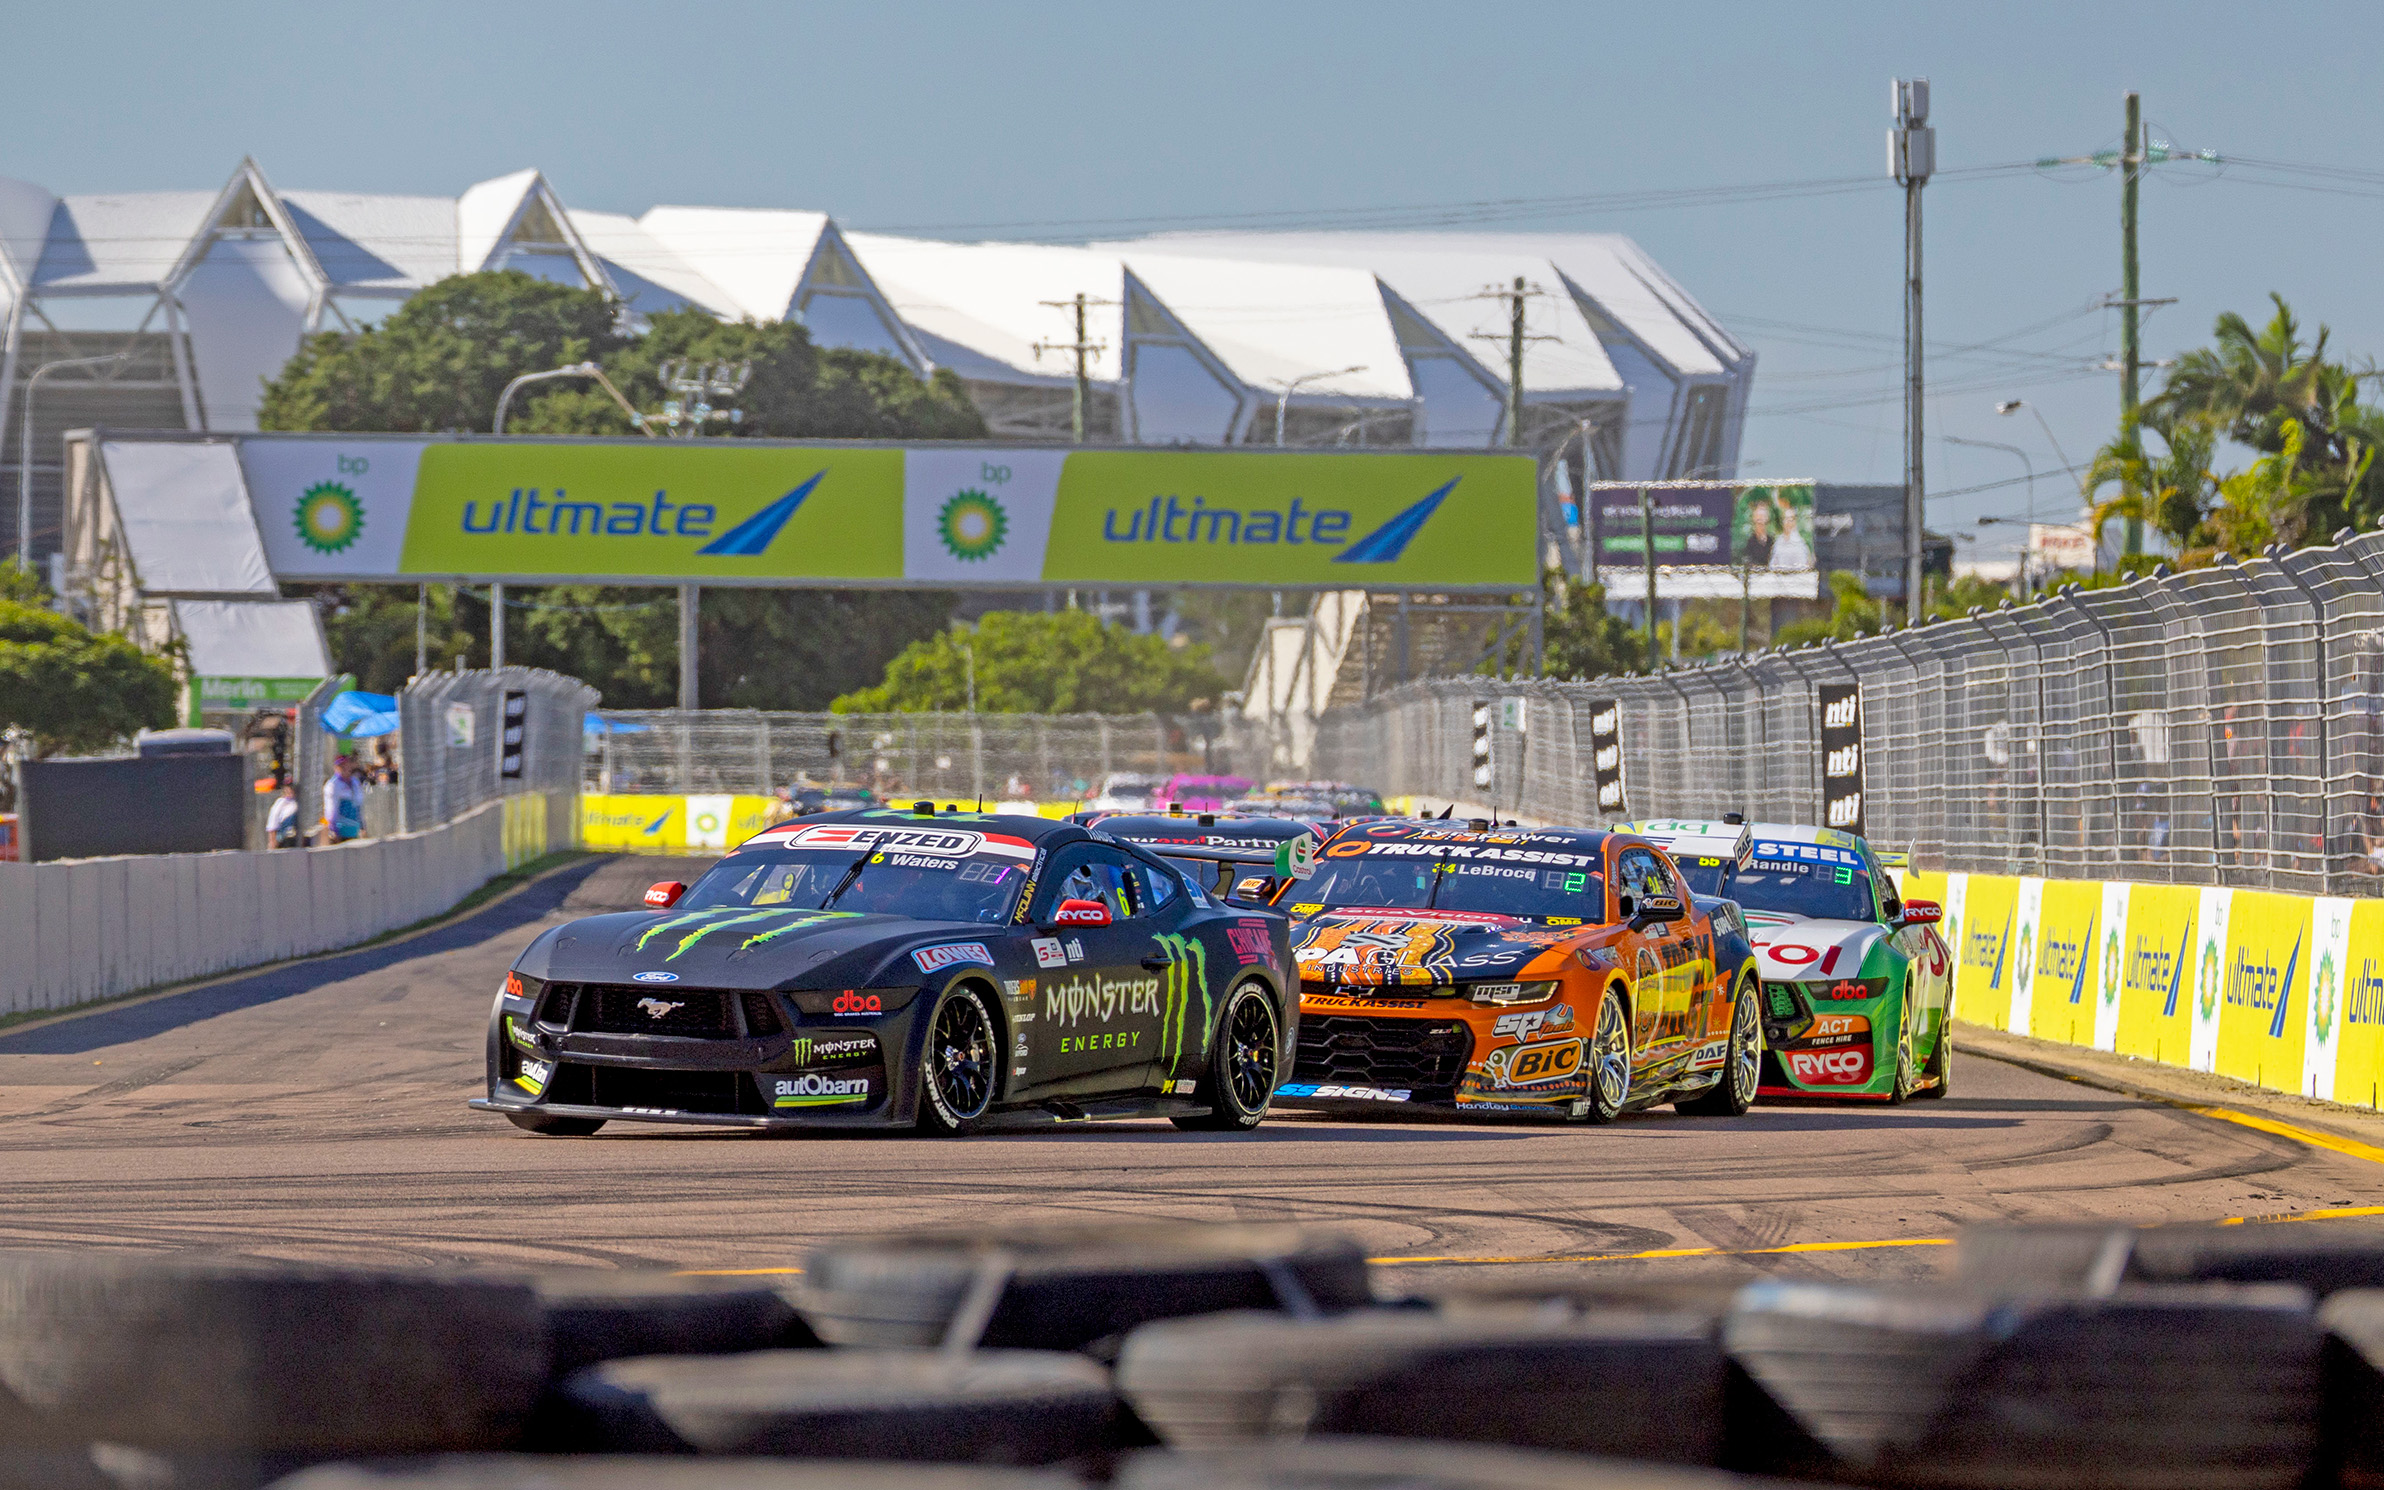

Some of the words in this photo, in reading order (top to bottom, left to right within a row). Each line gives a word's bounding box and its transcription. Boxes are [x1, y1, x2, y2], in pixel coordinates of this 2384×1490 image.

[338, 455, 369, 476] bp
[982, 463, 1012, 485] bp
[461, 489, 718, 537] ultimate
[1104, 496, 1352, 545] ultimate
[201, 678, 266, 697] Merlin
[1825, 694, 1856, 724] nti
[1828, 743, 1858, 773] nti
[1830, 792, 1860, 822] nti
[852, 831, 965, 850] ENZED
[870, 853, 885, 864] 6
[890, 854, 958, 869] Waters
[1758, 843, 1858, 866] STEEL
[1458, 864, 1537, 881] LeBrocq
[1699, 857, 1720, 867] 55
[1748, 860, 1809, 873] Randle
[1564, 873, 1586, 892] 2
[1116, 887, 1131, 916] 6
[1290, 903, 1325, 914] OMP
[1055, 909, 1104, 921] RYCO
[1546, 916, 1583, 926] OMP
[1905, 906, 1942, 918] RYCO
[2331, 911, 2341, 945] bp
[919, 945, 990, 970] LOWES
[2126, 934, 2170, 992] ultimate
[1307, 964, 1414, 975] INDUSTRIES
[2226, 945, 2277, 1010] ultimate
[1831, 980, 1868, 1000] dba
[832, 990, 882, 1013] dba
[1818, 1019, 1853, 1035] ACT
[1061, 1031, 1141, 1053] ENERGY
[1812, 1038, 1835, 1046] FENCE
[1836, 1035, 1853, 1044] HIRE
[822, 1051, 868, 1060] ENERGY
[1696, 1045, 1727, 1060] DAF
[1792, 1051, 1865, 1075] RYCO
[1456, 1102, 1510, 1111] Handley
